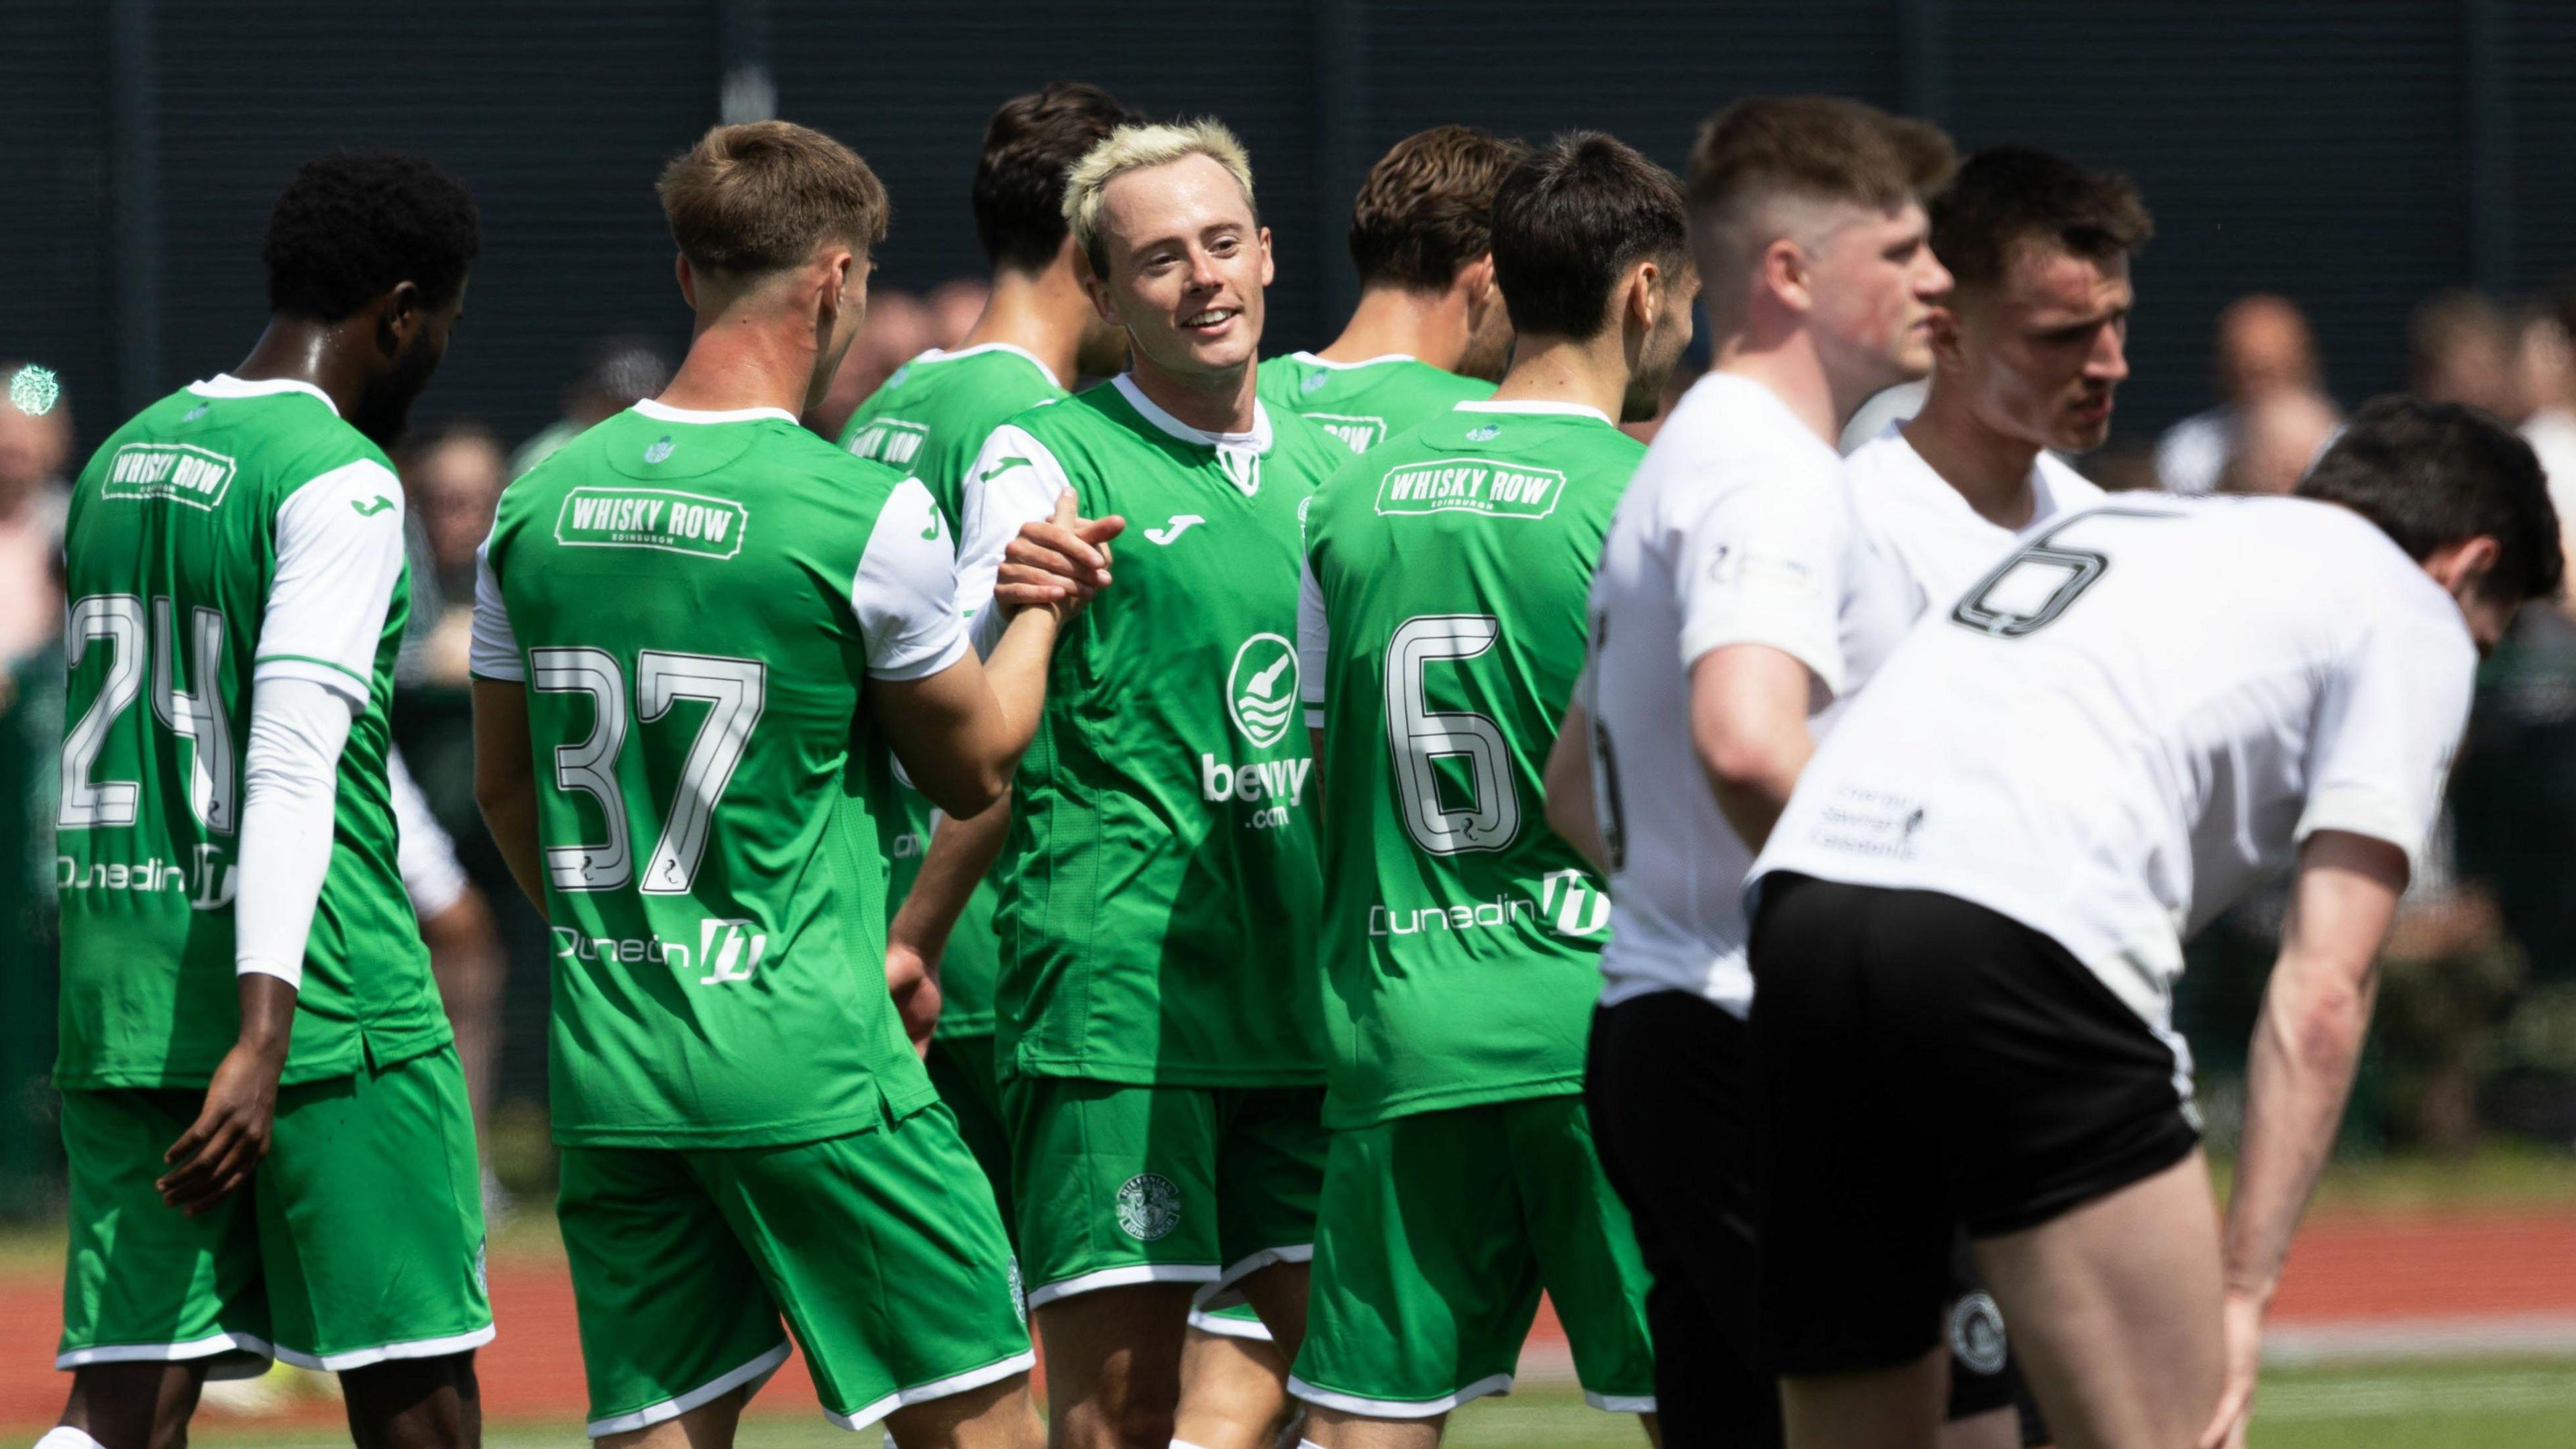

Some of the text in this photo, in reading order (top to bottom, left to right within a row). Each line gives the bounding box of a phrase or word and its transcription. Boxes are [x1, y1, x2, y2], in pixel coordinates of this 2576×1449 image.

[113, 453, 226, 494] WHISKY ROW
[1391, 468, 1552, 504] WHISKY ROW
[572, 497, 733, 543] WHISKY ROW
[1431, 499, 1493, 511] EDINBURGH
[612, 533, 674, 545] EDINBURGH
[56, 594, 235, 837] 24
[1384, 614, 1521, 857] 6
[529, 647, 767, 896] 37
[1368, 893, 1535, 935] Dunedin
